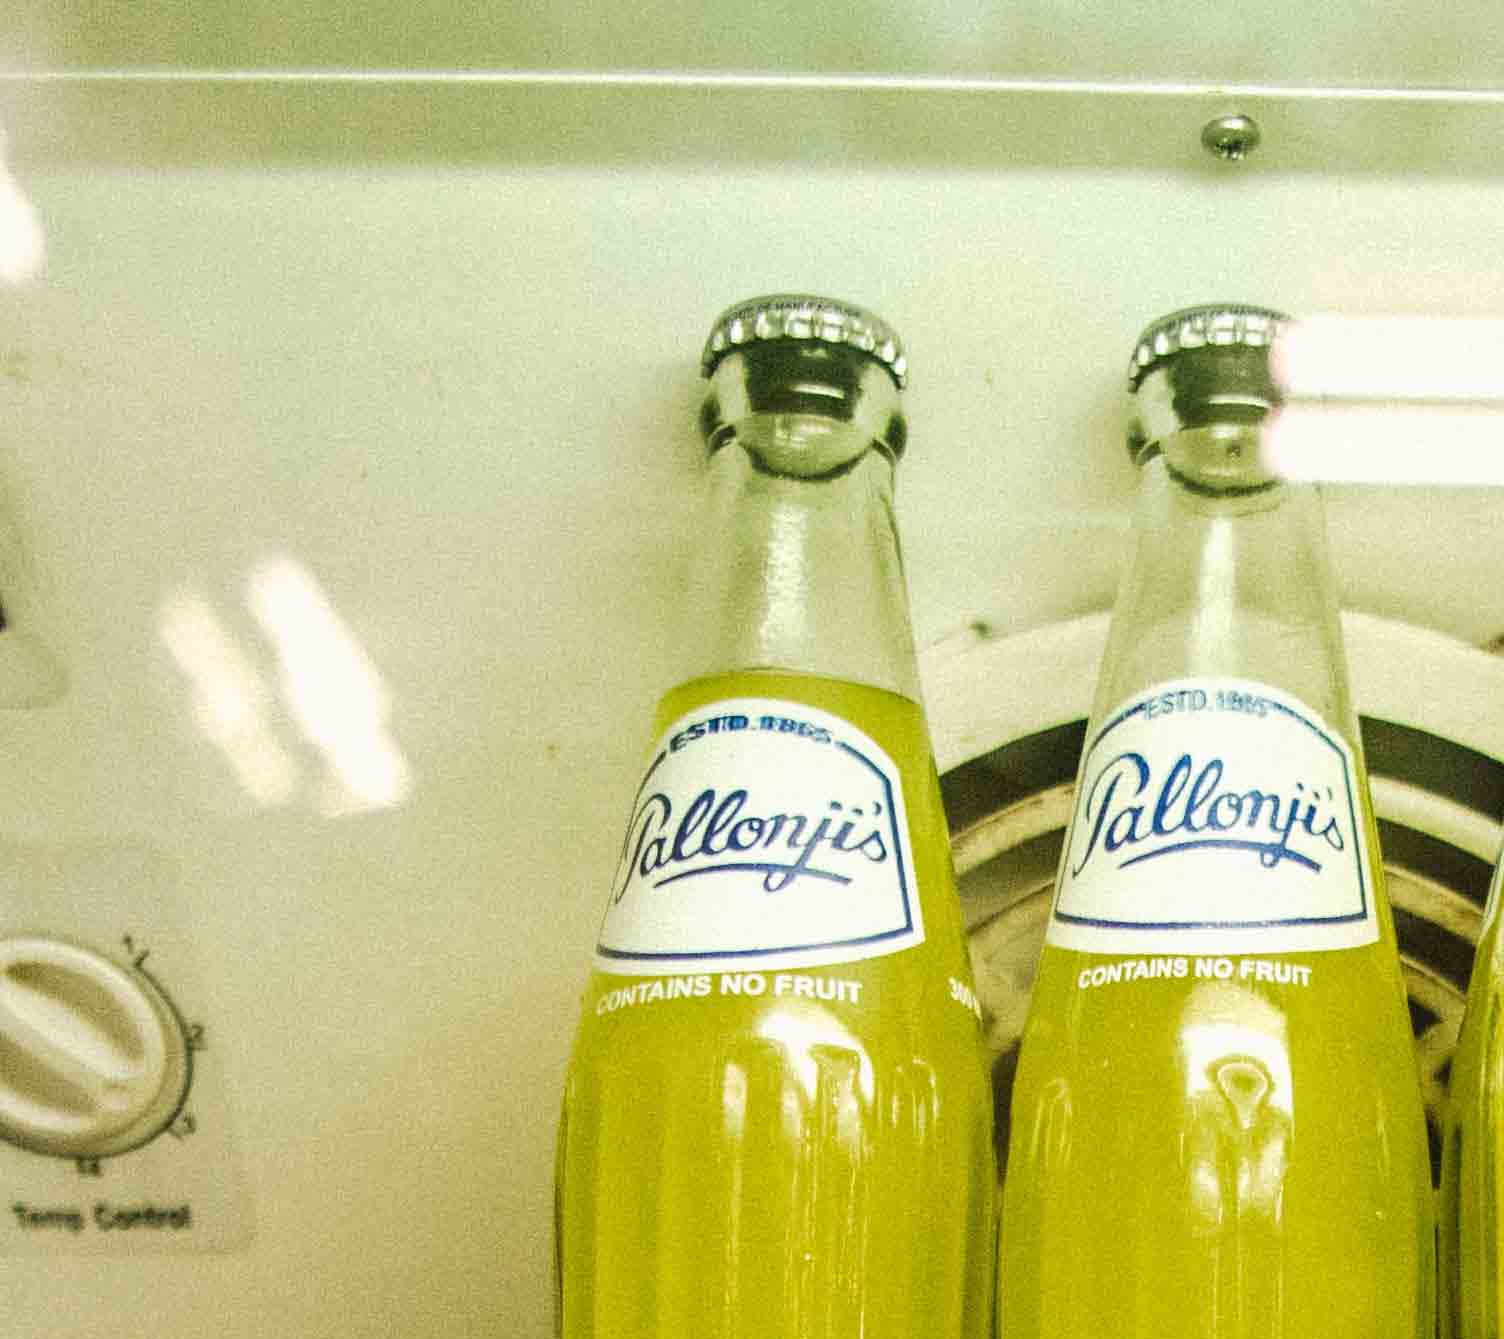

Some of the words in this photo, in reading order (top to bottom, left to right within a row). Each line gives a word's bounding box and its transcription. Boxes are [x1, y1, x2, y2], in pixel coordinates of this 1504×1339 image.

[614, 788, 889, 905] Pallonji's
[1072, 752, 1345, 881] Pallonji's
[596, 975, 712, 1017] CONTAINS
[720, 973, 765, 996] NO
[774, 974, 864, 1004] FRUIT
[1078, 958, 1189, 990] CONTAINS
[1194, 957, 1233, 980] NO
[1239, 957, 1312, 987] FRUIT
